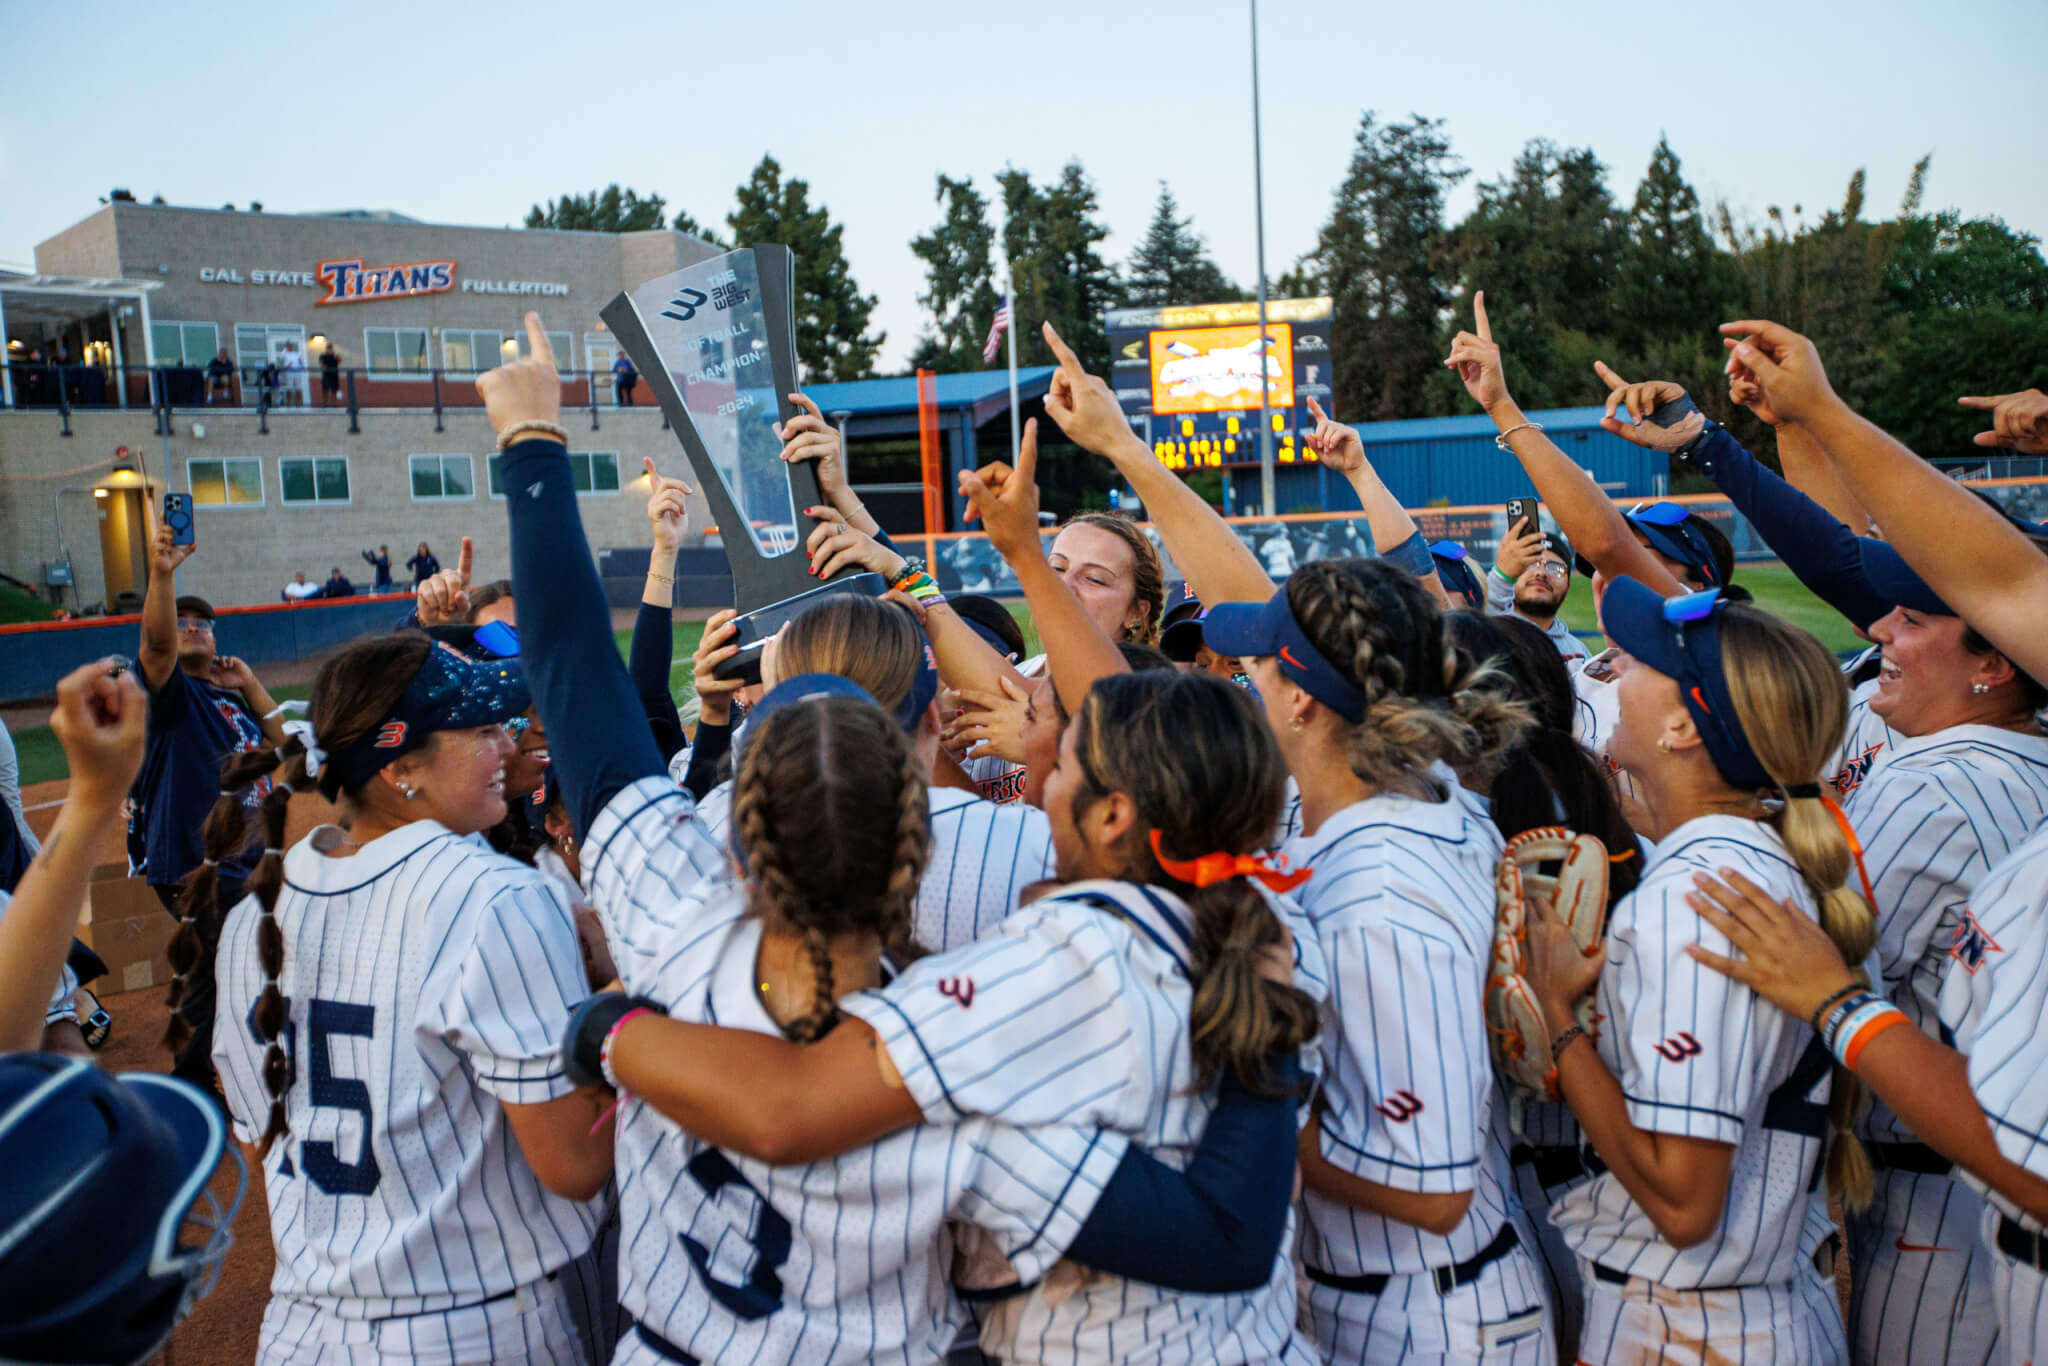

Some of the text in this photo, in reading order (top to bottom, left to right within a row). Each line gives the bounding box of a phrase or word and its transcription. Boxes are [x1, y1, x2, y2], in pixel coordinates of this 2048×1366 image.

[200, 259, 569, 303] CAL STATE TITANS FULLERTON
[713, 288, 752, 312] WEST
[686, 350, 761, 386] CHAMPION
[716, 394, 755, 417] 2024
[678, 1146, 793, 1321] 3
